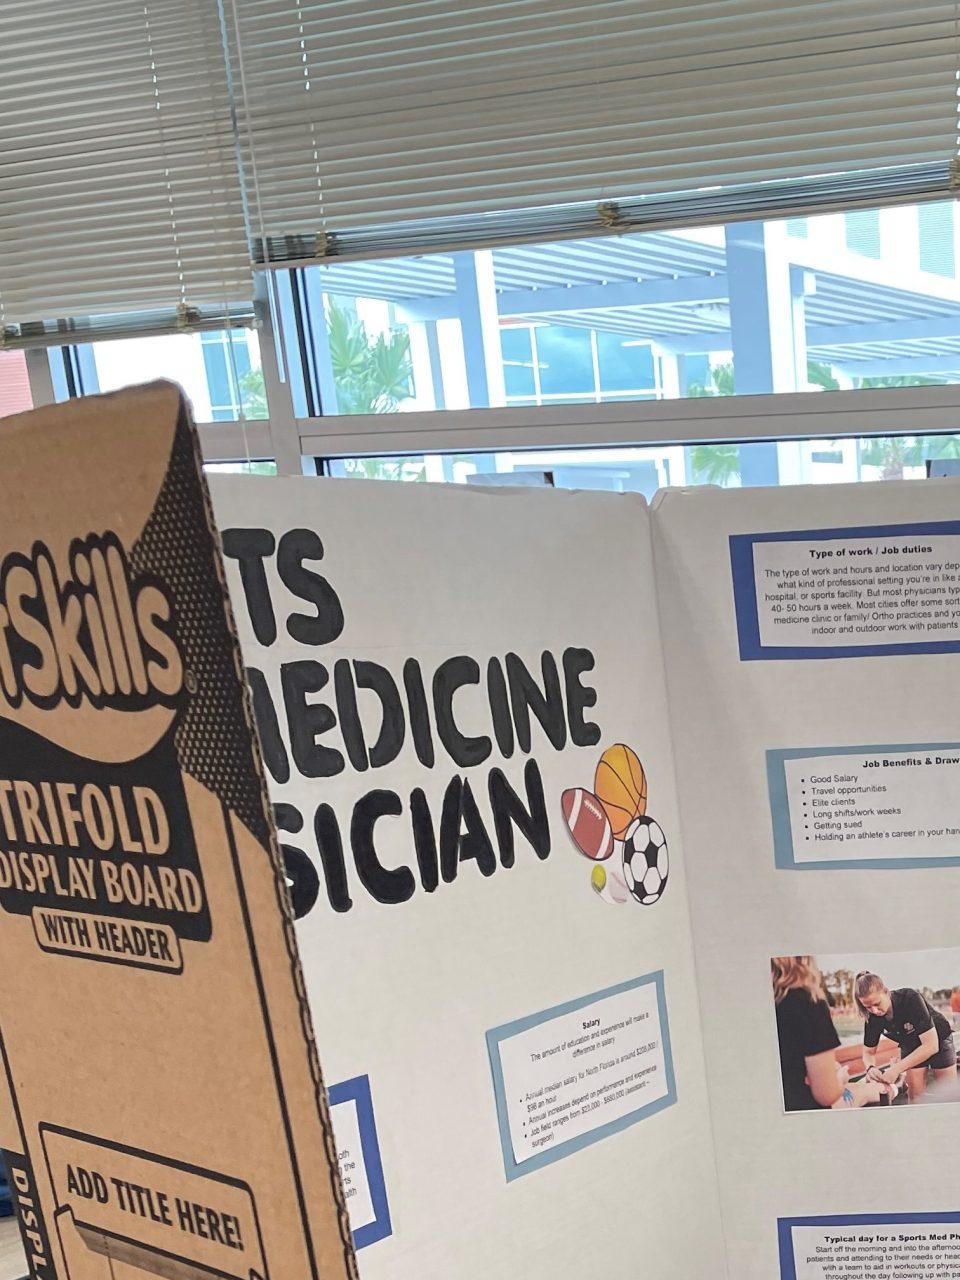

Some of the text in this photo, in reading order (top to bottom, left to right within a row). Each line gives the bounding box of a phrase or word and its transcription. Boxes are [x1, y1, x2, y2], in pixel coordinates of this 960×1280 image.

[809, 550, 833, 558] Type
[849, 548, 873, 556] work
[881, 546, 899, 554] Job
[902, 545, 932, 553] duties
[765, 569, 780, 578] The
[782, 569, 800, 578] type
[802, 567, 810, 576] of
[812, 567, 831, 575] work
[833, 566, 848, 574] and
[850, 565, 873, 574] hours
[892, 563, 923, 572] location
[925, 563, 942, 572] vary
[827, 577, 875, 587] professional
[878, 576, 903, 586] setting
[906, 575, 931, 584] you're
[942, 574, 955, 582] like
[812, 621, 958, 634] indoor and outdoor work with patients
[863, 759, 880, 768] Job
[883, 758, 922, 767] Benefits
[925, 757, 932, 765] &
[810, 774, 858, 783] Good Salary
[811, 785, 886, 795] Travel opportunities
[812, 799, 829, 807] Elite
[0, 779, 171, 856] TRIFOLD
[813, 810, 832, 819] Long
[834, 808, 875, 817] shifts/work
[814, 821, 842, 830] Getting
[815, 833, 844, 842] Holding
[858, 830, 889, 839] athlete's
[892, 829, 916, 837] career
[927, 828, 943, 838] your
[101, 861, 202, 913] BOARD
[40, 913, 173, 962] WITH HEADER
[582, 1018, 600, 1029] Salary
[67, 1164, 245, 1251] ADD TITLE HERE!
[824, 1236, 856, 1244] Typical
[858, 1235, 874, 1243] day
[898, 1234, 926, 1243] Sports
